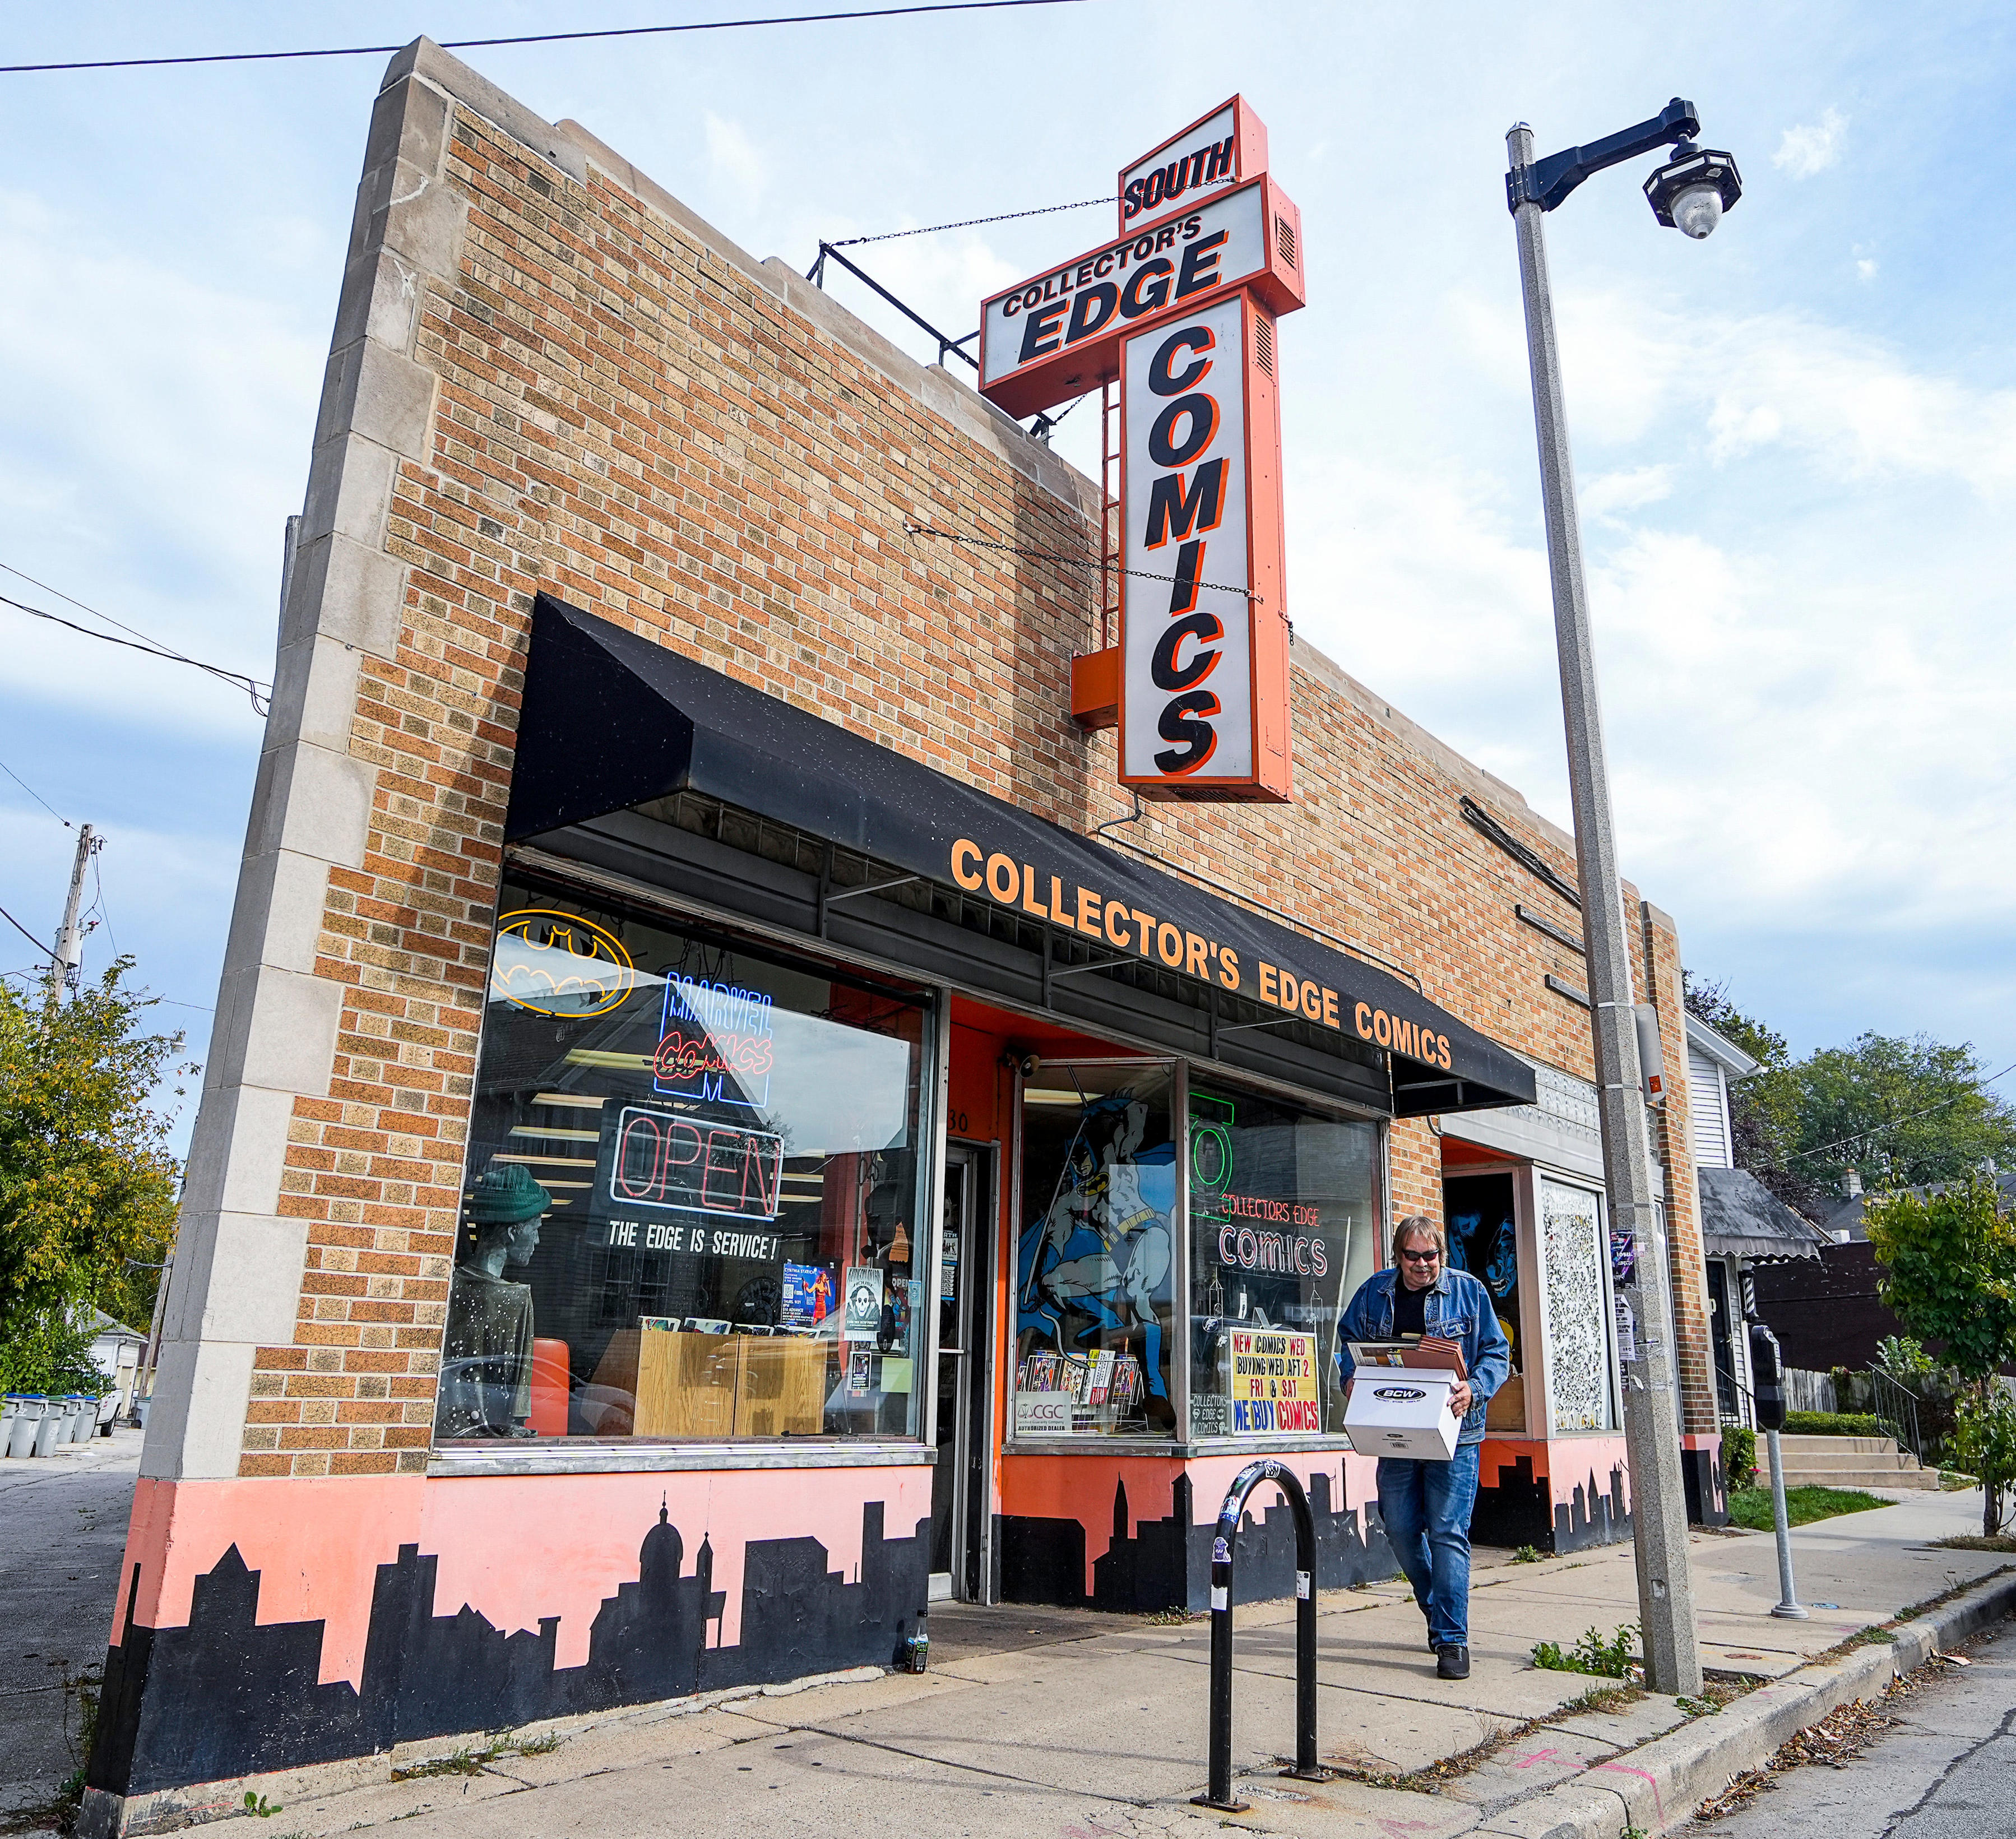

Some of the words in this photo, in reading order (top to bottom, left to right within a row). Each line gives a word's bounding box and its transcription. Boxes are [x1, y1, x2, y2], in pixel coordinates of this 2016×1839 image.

[1124, 135, 1235, 220] SOUTH
[1002, 216, 1201, 318] COLLECTOR'S
[1017, 229, 1230, 366] EDGE
[1144, 325, 1230, 777] COMICS
[951, 838, 1240, 990] COLLECTOR'S
[1258, 961, 1340, 1030] EDGE
[1355, 1001, 1452, 1070] COMICS
[664, 971, 773, 1039] MARVEL
[620, 1117, 780, 1216] OPEN
[1222, 1193, 1289, 1222] COLLECTORS
[1293, 1205, 1320, 1227] EDGE
[609, 1220, 639, 1247] THE
[646, 1224, 684, 1250] EDGE
[690, 1228, 705, 1252] IS
[1234, 1335, 1252, 1354] NEW
[1256, 1336, 1286, 1354] COMICS
[1290, 1338, 1305, 1356] WED
[1237, 1356, 1266, 1375] BUYING
[1268, 1358, 1284, 1376] WED
[1287, 1359, 1300, 1377] AFT
[1304, 1359, 1309, 1377] 2
[1193, 1395, 1227, 1407] COLLECTORS
[1250, 1379, 1263, 1397] FRI
[1271, 1380, 1276, 1397] &
[1282, 1379, 1296, 1398] SAT
[1034, 1405, 1063, 1419] CGC
[1197, 1422, 1218, 1433] COMICS
[1202, 1409, 1216, 1420] EDGE
[1234, 1400, 1250, 1431] WE
[1252, 1400, 1274, 1430] BUY
[1277, 1400, 1318, 1430] COMICS
